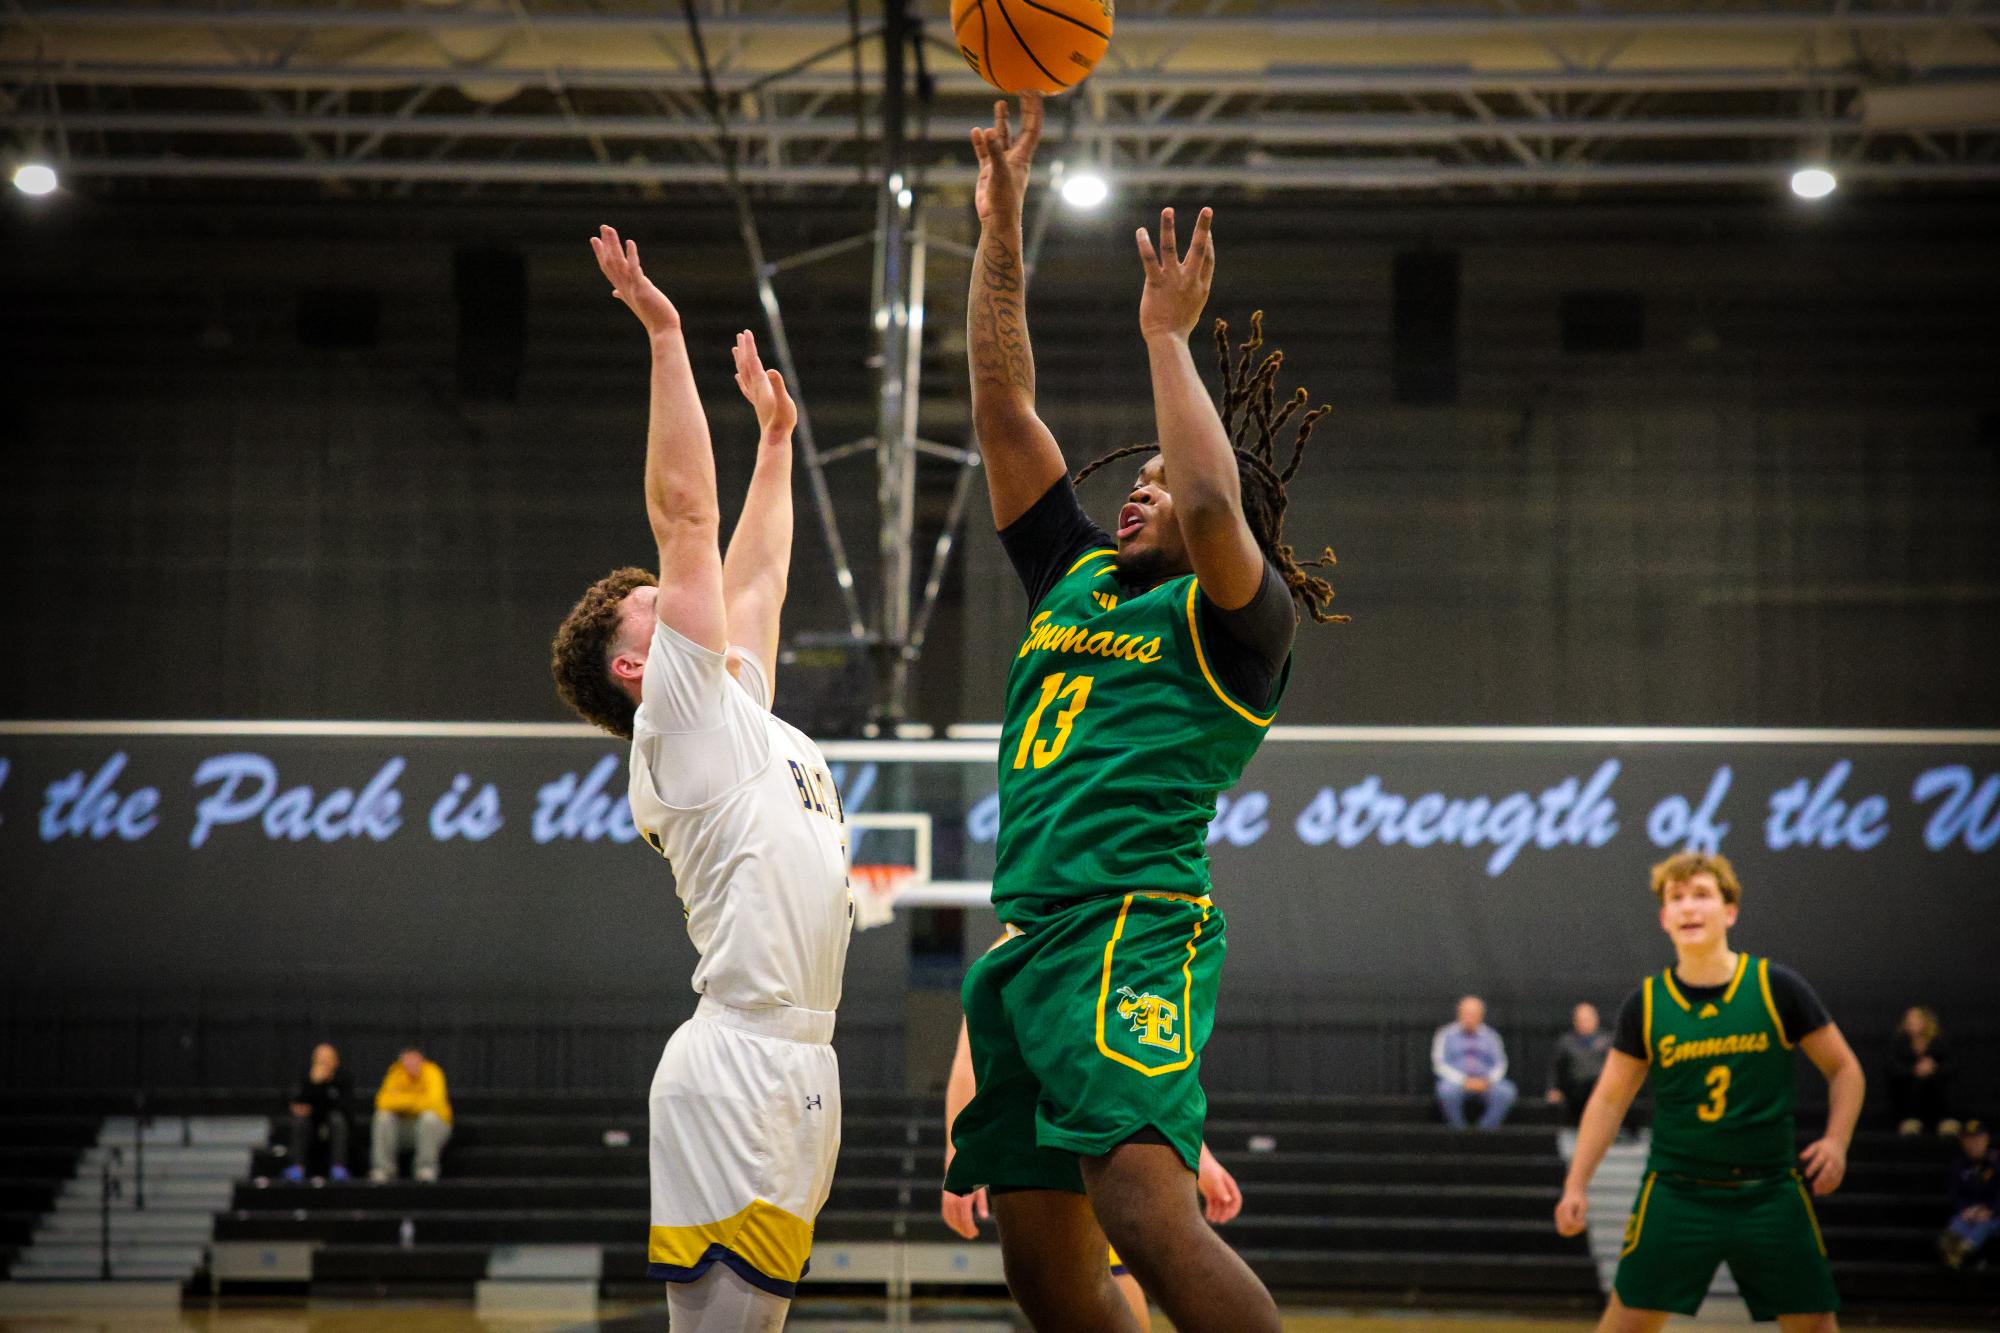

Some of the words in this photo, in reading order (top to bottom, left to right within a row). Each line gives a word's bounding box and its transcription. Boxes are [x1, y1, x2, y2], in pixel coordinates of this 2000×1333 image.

[1018, 610, 1163, 664] Emmaus
[1012, 672, 1095, 770] 13
[39, 752, 160, 841] the
[188, 753, 406, 850] Pack
[430, 772, 503, 842] is
[531, 753, 639, 844] the
[1295, 757, 1622, 877] strength
[1646, 764, 1734, 856] of
[1764, 759, 1889, 852] the
[1657, 1031, 1770, 1069] Emmaus
[1696, 1065, 1732, 1122] 3
